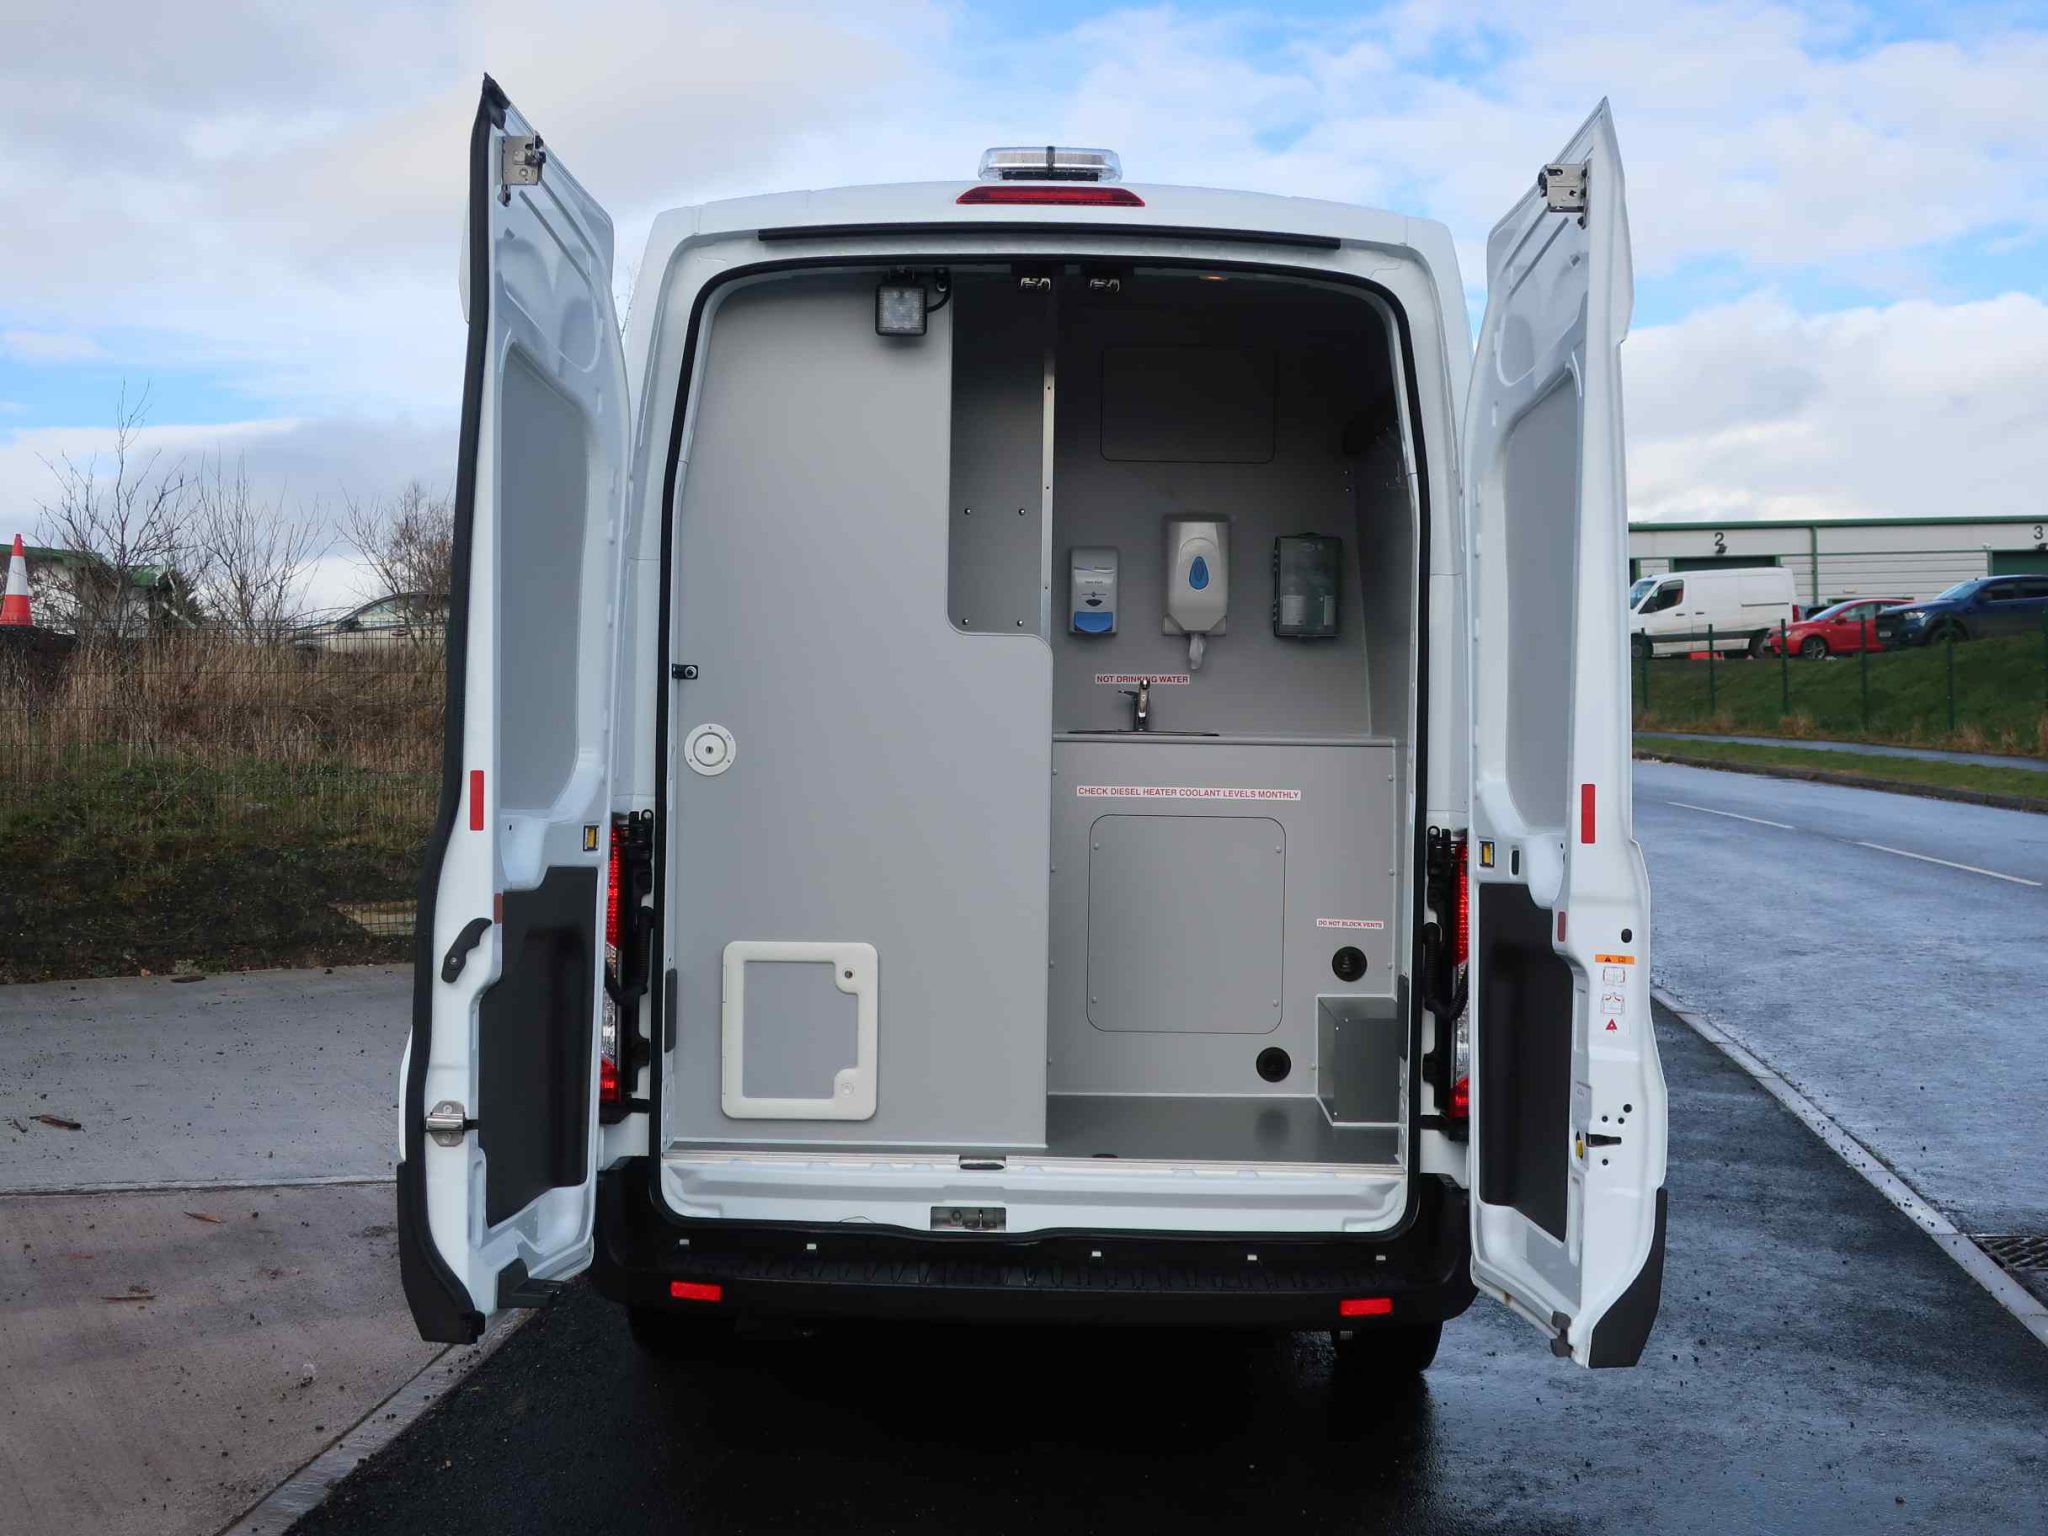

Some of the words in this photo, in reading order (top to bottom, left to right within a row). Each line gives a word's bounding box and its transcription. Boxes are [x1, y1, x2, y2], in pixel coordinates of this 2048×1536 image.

[1714, 531, 1725, 547] 2
[2033, 524, 2044, 540] 3
[1096, 675, 1115, 683] NOT
[1078, 787, 1108, 795] CHECK
[1110, 787, 1141, 796] DIESEL
[1143, 788, 1177, 797] HEATER
[1179, 788, 1222, 797] COOLANT
[1223, 789, 1257, 798] LEVELS
[1258, 790, 1299, 799] MONTHLY
